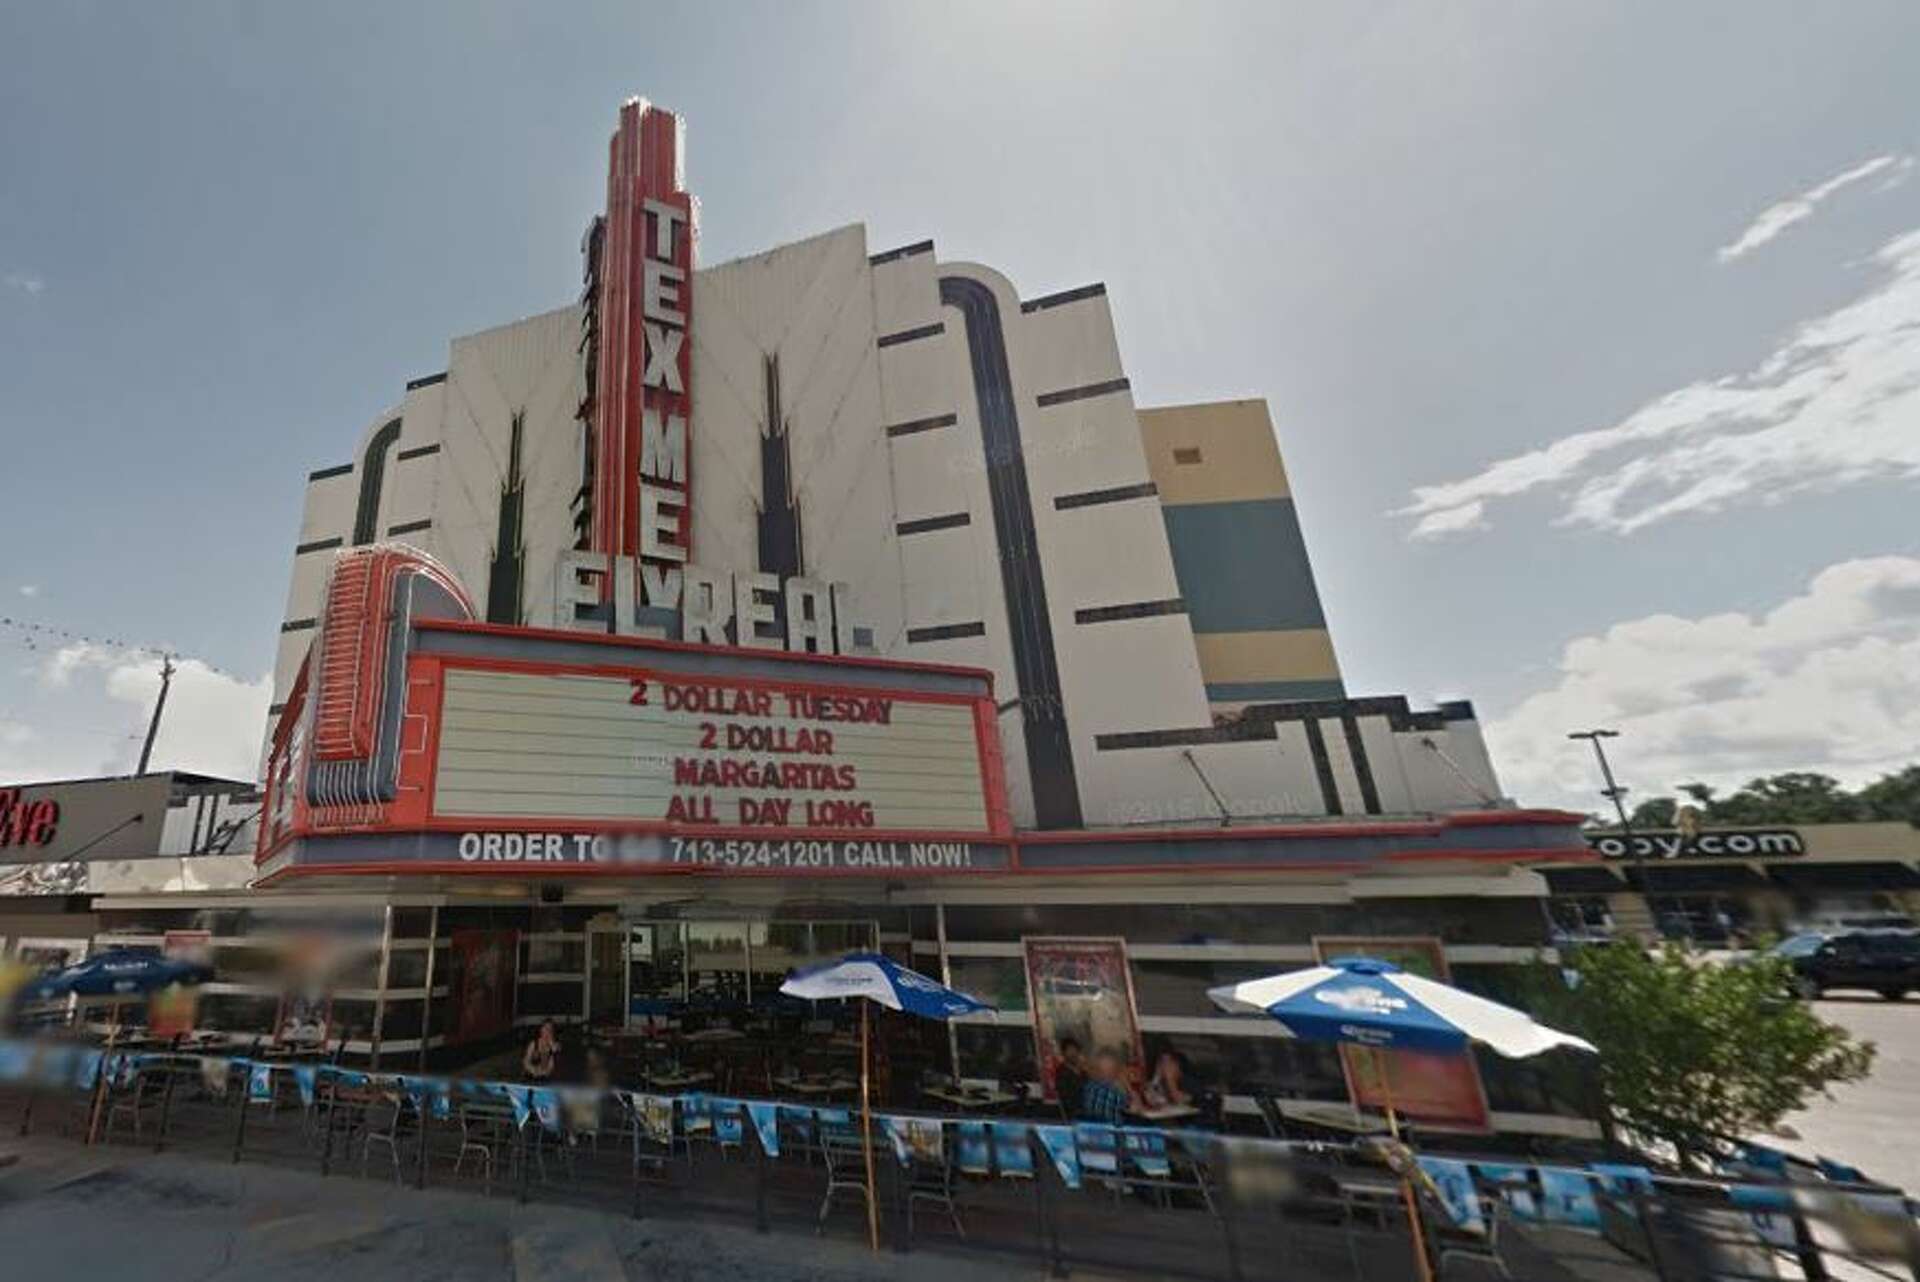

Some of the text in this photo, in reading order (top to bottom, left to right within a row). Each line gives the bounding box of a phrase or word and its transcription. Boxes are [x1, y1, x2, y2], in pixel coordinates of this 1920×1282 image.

[641, 200, 687, 394] TEX
[551, 549, 879, 660] EL REAL
[629, 679, 893, 725] 2 DOLLAR TUESDAY
[699, 722, 833, 756] 2 DOLLAR
[674, 756, 857, 791] MARGARITAS
[665, 795, 875, 828] ALL DAY LONG
[458, 832, 564, 862] ORDER
[670, 837, 834, 867] 713-524-1201
[844, 840, 903, 867] CALL
[909, 842, 972, 868] NOW!
